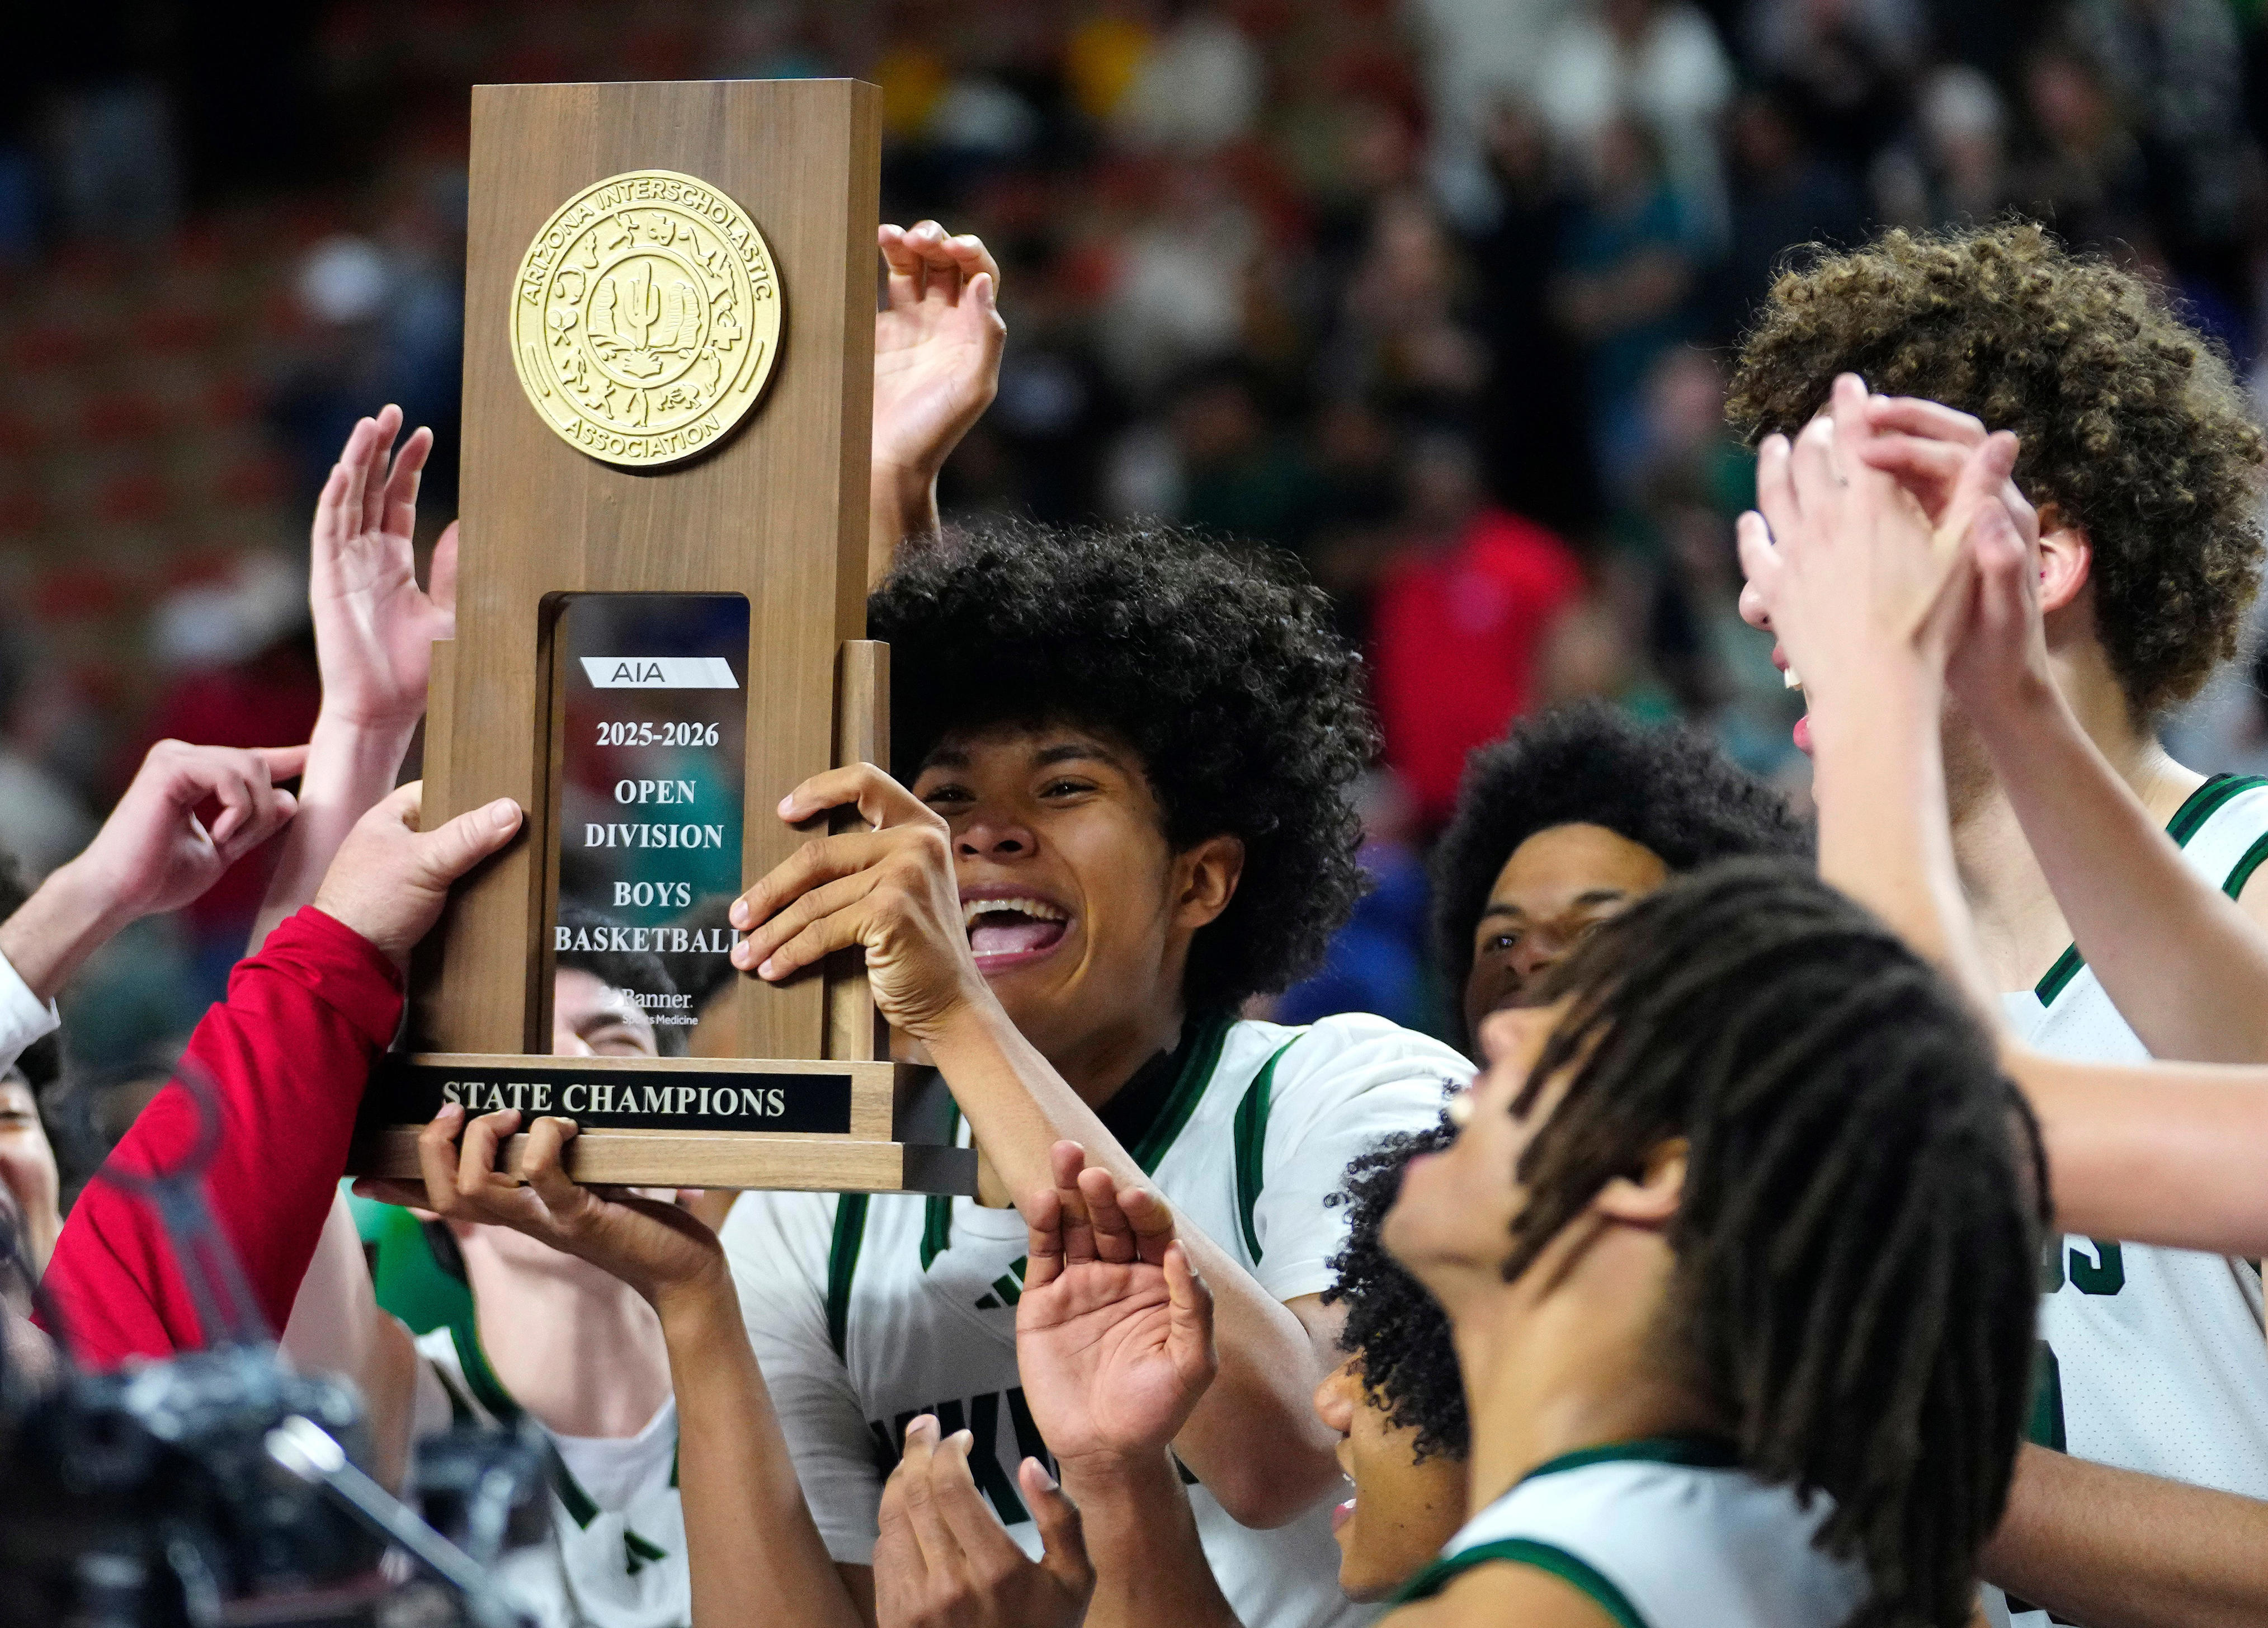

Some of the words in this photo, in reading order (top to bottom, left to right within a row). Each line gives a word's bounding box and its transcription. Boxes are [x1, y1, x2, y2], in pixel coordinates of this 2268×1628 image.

[522, 205, 595, 305] ARIZONA
[598, 178, 772, 300] INTERSCHOLASTIC
[565, 415, 720, 458] ASSOCIATION
[611, 662, 666, 682] AIA
[596, 722, 719, 746] 2025-2026
[615, 779, 696, 804] OPEN
[584, 824, 724, 849] DIVISION
[613, 881, 691, 907] BOYS
[656, 1014, 699, 1025] Medicine
[442, 1081, 553, 1111] STATE
[563, 1084, 785, 1116] CHAMPIONS
